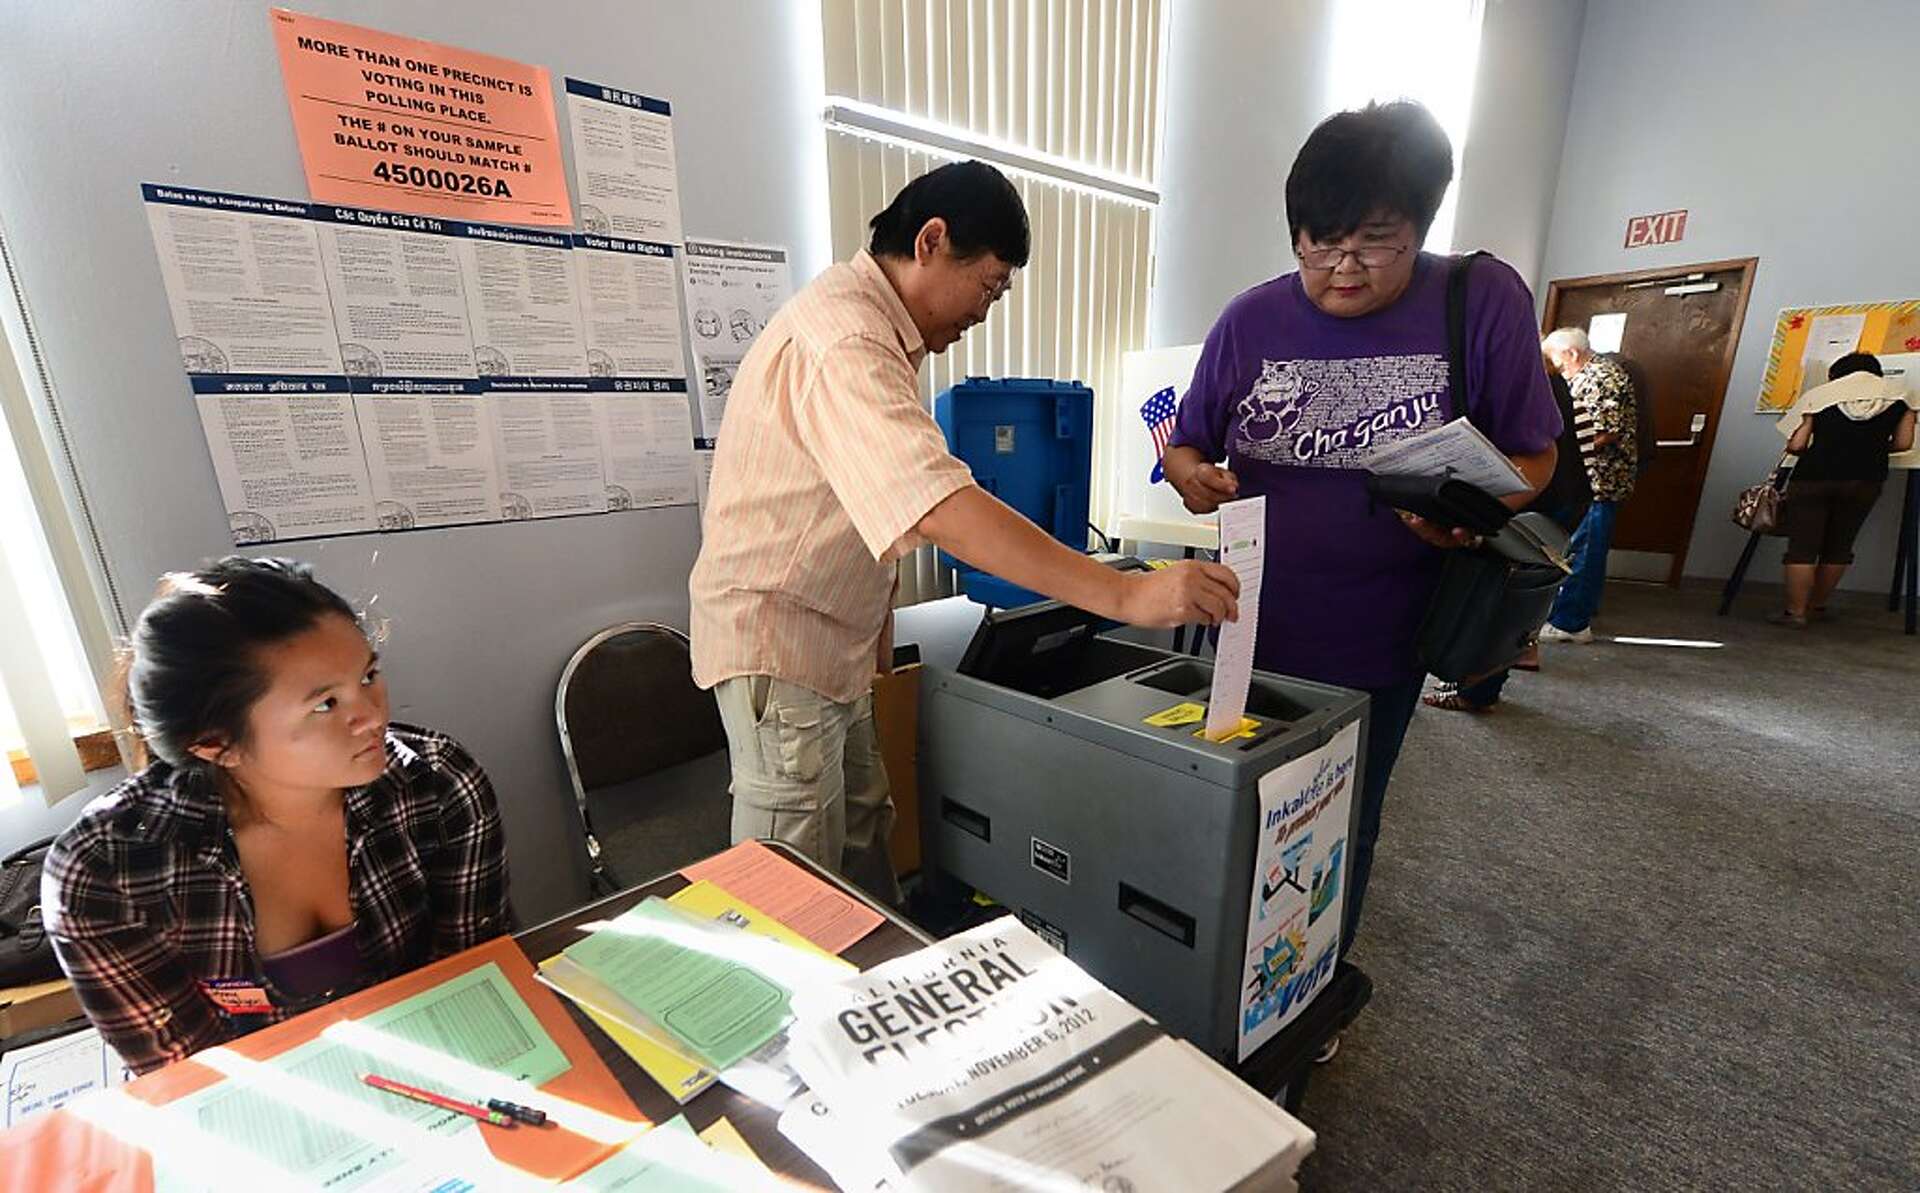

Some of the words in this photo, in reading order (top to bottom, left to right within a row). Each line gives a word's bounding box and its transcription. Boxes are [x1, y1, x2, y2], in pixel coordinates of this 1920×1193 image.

[297, 36, 350, 58] MORE
[353, 48, 400, 68] THAN
[405, 59, 439, 76] ONE
[442, 67, 514, 92] PRECINCT
[519, 84, 532, 96] IS
[361, 70, 424, 92] VOTING
[429, 83, 445, 96] IN
[449, 87, 485, 104] THIS
[366, 90, 436, 113] POLLING
[440, 104, 491, 124] PLACE.
[333, 133, 398, 153] BALLOT
[403, 144, 465, 164] SHOULD
[469, 155, 520, 172] MATCH
[337, 114, 372, 130] THE
[391, 124, 415, 137] ON
[419, 128, 462, 145] YOUR
[466, 137, 523, 156] SAMPLE
[373, 160, 513, 198] 4500026A
[584, 236, 609, 248] Voter
[1628, 212, 1686, 246] EXIT
[838, 951, 1038, 1045] GENERAL
[966, 1035, 1047, 1080] NOVEMBER
